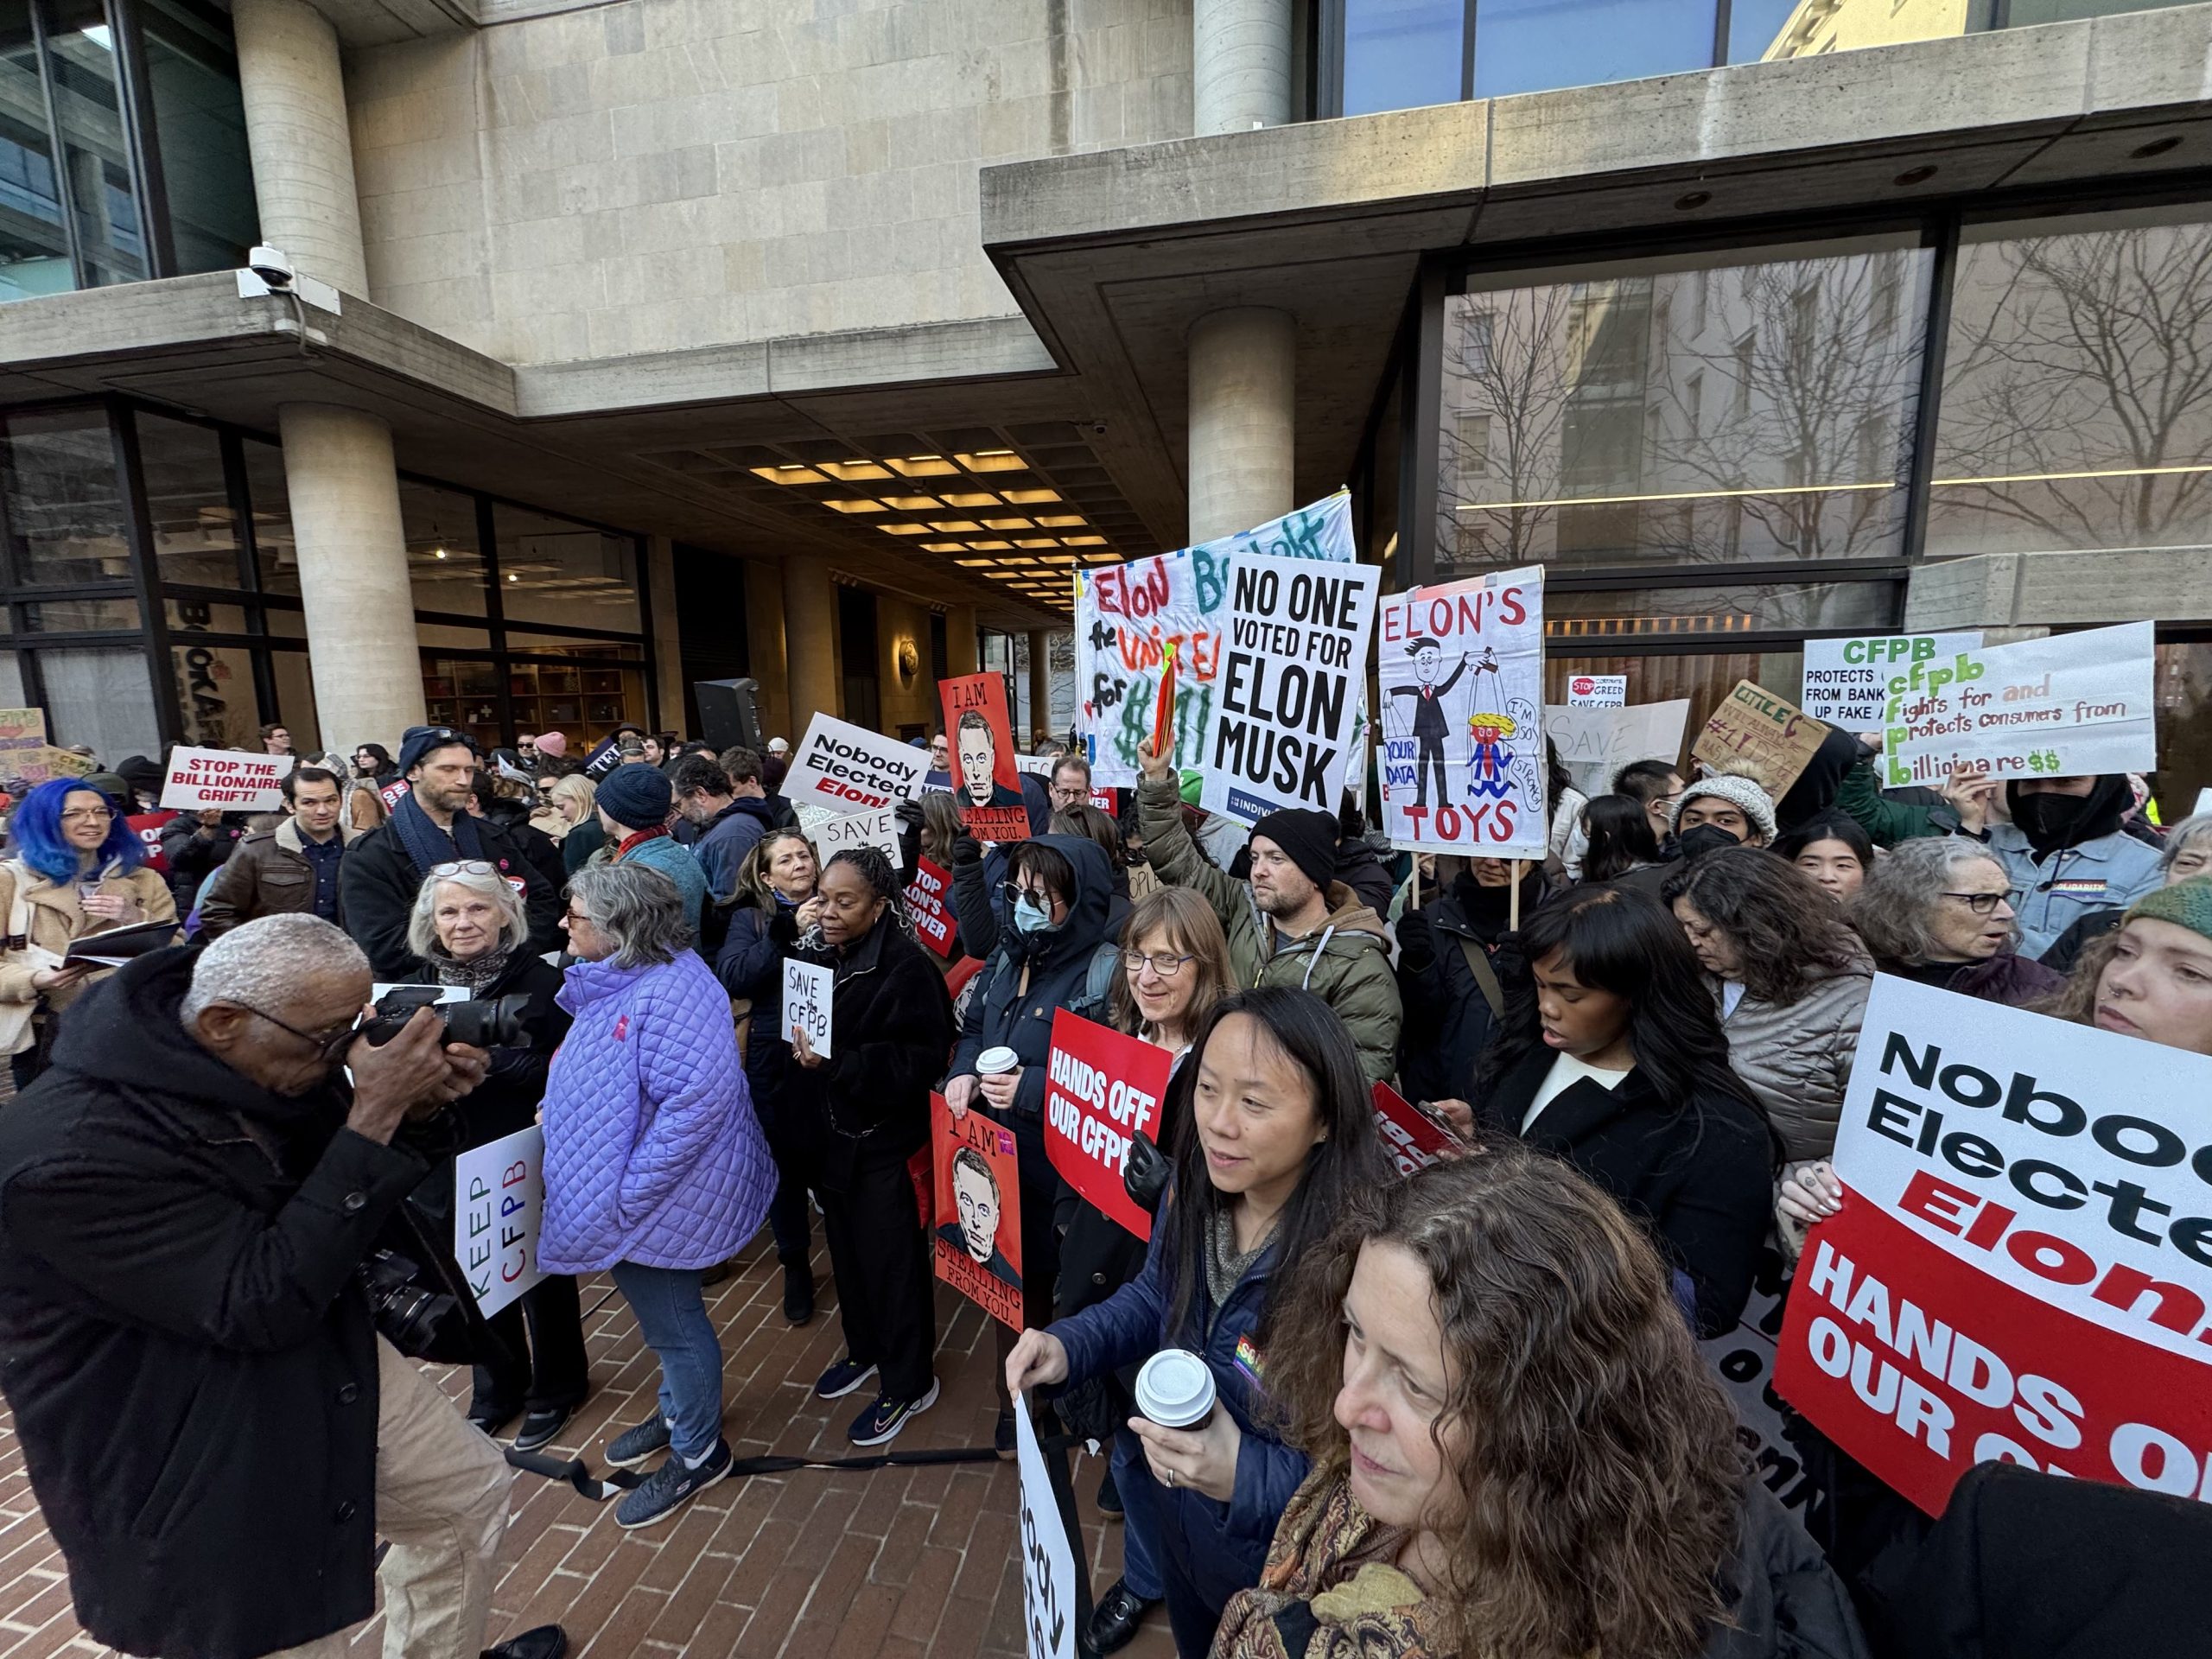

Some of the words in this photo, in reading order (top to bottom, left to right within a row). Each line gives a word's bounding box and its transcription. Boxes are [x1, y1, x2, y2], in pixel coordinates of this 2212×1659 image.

[1234, 567, 1279, 616] NO
[1288, 574, 1364, 631] ONE
[1385, 588, 1526, 642] ELON'S
[1233, 618, 1300, 658] VOTED
[1306, 631, 1352, 670] FOR
[1843, 638, 1936, 664] CFPB
[1573, 682, 1594, 690] STOP
[1594, 686, 1624, 695] GREED
[1806, 670, 1873, 683] PROTECTS
[1888, 653, 1984, 697] cfpb
[953, 686, 961, 709] I
[965, 683, 988, 707] AM
[1092, 673, 1128, 717] for
[1223, 652, 1347, 741] ELON
[1510, 701, 1532, 721] I'M
[1806, 689, 1840, 702] FROM
[1815, 706, 1831, 719] UP
[1838, 706, 1872, 719] FAKE
[1885, 696, 1948, 723] fights
[1959, 688, 1992, 709] for
[2003, 674, 2050, 701] and
[1521, 726, 1532, 740] SO
[1550, 715, 1632, 756] SAVE
[1887, 713, 1972, 755] protects
[1979, 708, 2063, 727] consumers
[2074, 702, 2126, 722] from
[188, 759, 239, 774] STOP
[244, 763, 277, 776] THE
[814, 734, 918, 783] Nobody
[1214, 715, 1337, 809] MUSK
[1385, 740, 1415, 762] YOUR
[171, 772, 283, 790] BILLIONAIRE
[806, 753, 912, 799] Elected
[815, 777, 891, 809] Elon!
[1386, 766, 1418, 785] DATA
[198, 789, 257, 802] GRIFT!
[827, 814, 892, 842] SAVE
[992, 826, 1022, 839] YOU.
[1403, 799, 1518, 842] TOYS
[903, 885, 942, 915] LON'S
[916, 868, 941, 893] TOP
[789, 966, 819, 999] SAVE
[789, 1002, 828, 1038] CFPB
[1050, 1046, 1107, 1110] HANDS
[1109, 1079, 1156, 1131] OFF
[1049, 1091, 1081, 1145] OUR
[1879, 1031, 2212, 1188] Nobo
[969, 1120, 997, 1158] AM
[470, 1176, 491, 1301] KEEP
[502, 1160, 526, 1283] CFPB
[937, 1238, 1021, 1310] STEALING
[947, 1265, 980, 1301] FROM
[985, 1296, 1014, 1325] YOU.
[1808, 1239, 2085, 1449] HANDS
[1808, 1316, 1955, 1462] OUR
